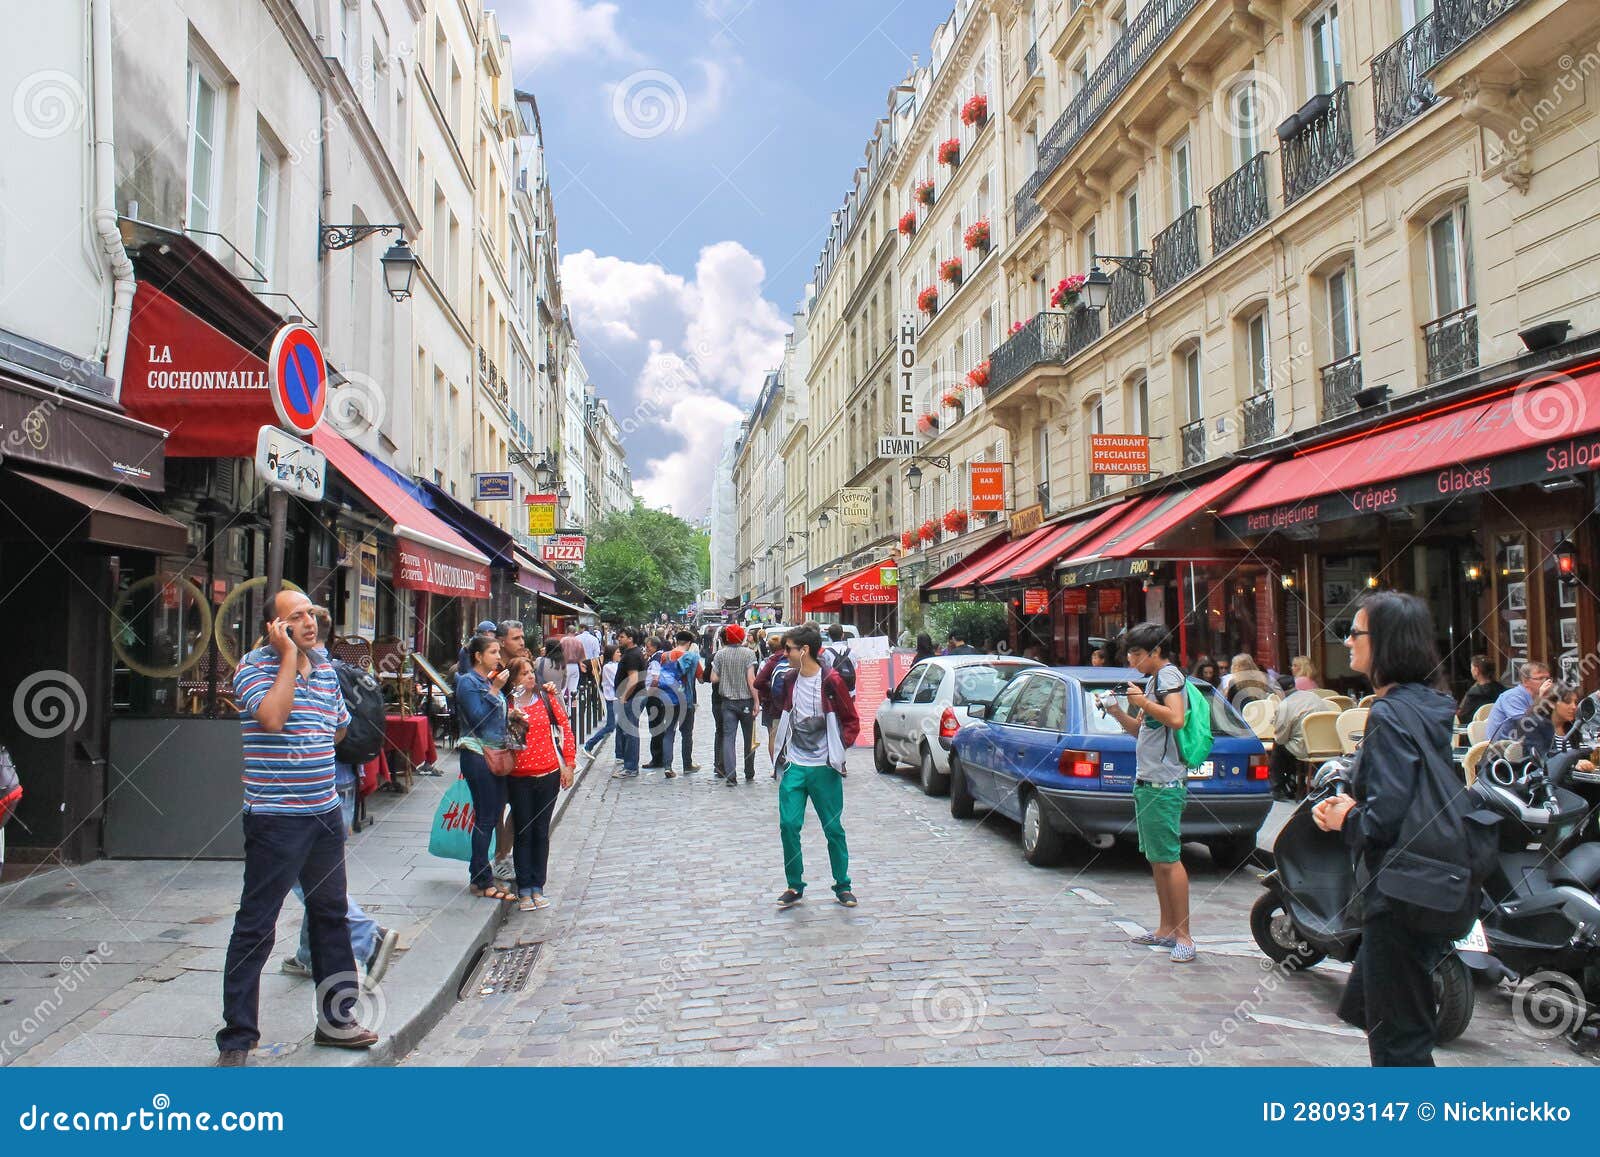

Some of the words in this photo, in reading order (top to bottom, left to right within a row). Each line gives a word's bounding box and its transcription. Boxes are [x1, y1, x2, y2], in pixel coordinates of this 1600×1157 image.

[149, 345, 172, 363] LA
[901, 326, 915, 436] HOTEL
[1093, 438, 1146, 446] RESTAURANT
[1094, 451, 1146, 459] SPECIALITES
[1437, 465, 1492, 493] Glaces
[1352, 487, 1398, 511] Crêpes
[844, 508, 868, 517] Cluny
[1248, 514, 1270, 529] Petit
[1272, 505, 1319, 528] déjeuner
[545, 546, 582, 559] PIZZA
[1130, 560, 1148, 574] FOOD
[862, 592, 890, 602] Cluny
